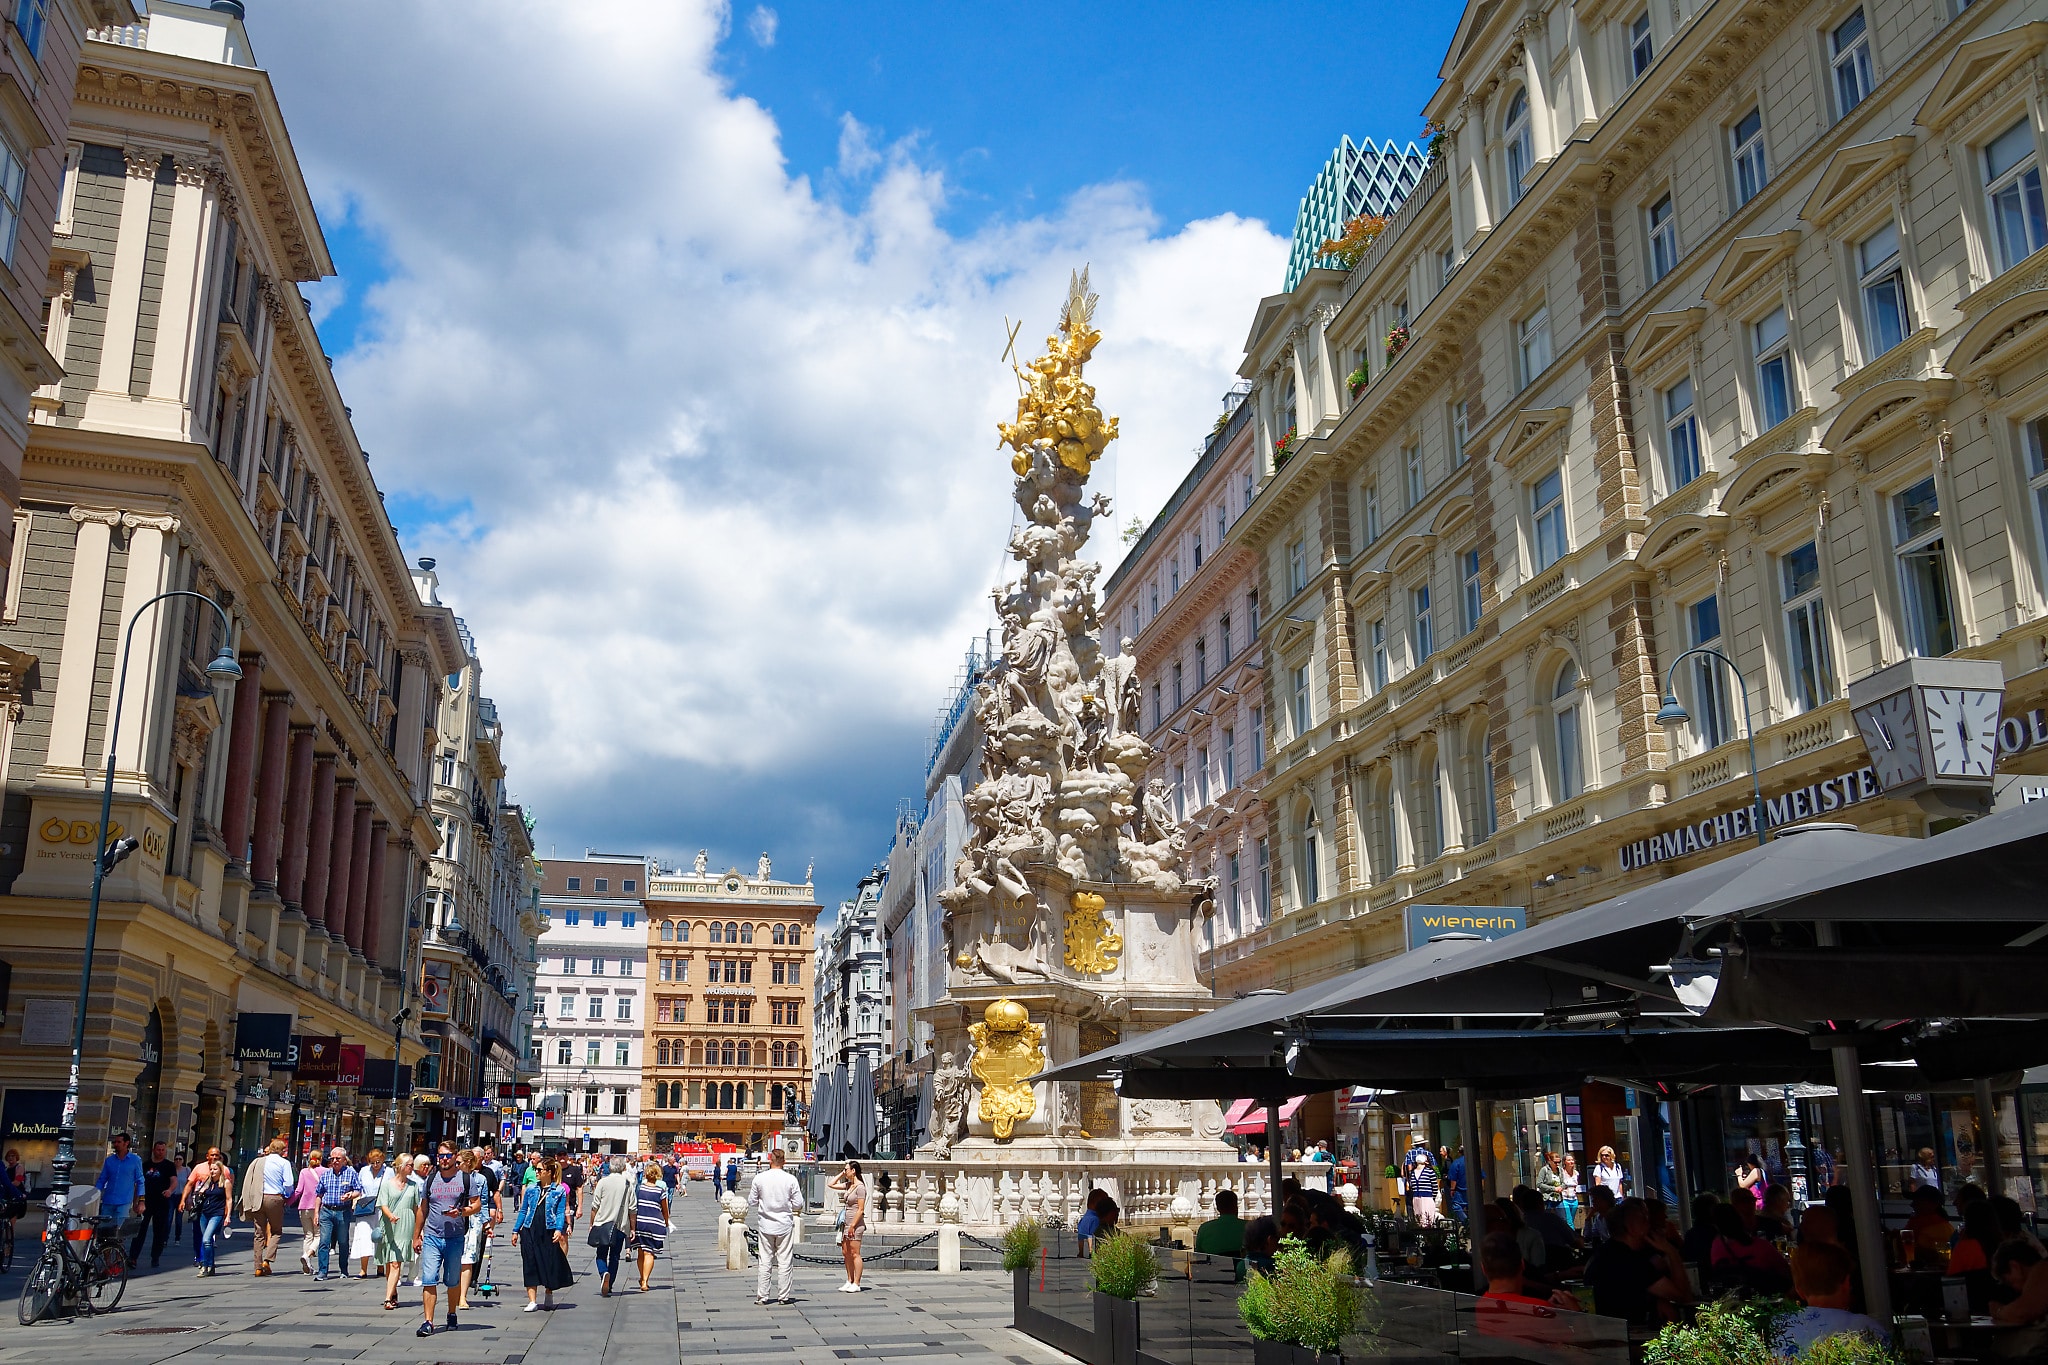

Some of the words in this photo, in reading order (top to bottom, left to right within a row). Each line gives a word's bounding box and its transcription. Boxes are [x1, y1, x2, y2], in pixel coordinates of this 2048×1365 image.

[1618, 765, 1882, 872] UHRMACHEMEISTE
[36, 849, 57, 858] Ihre
[1422, 915, 1516, 929] wienerin
[239, 1048, 282, 1059] MaxMara
[1904, 1092, 1922, 1101] ORIS
[12, 1122, 59, 1134] MaxMara
